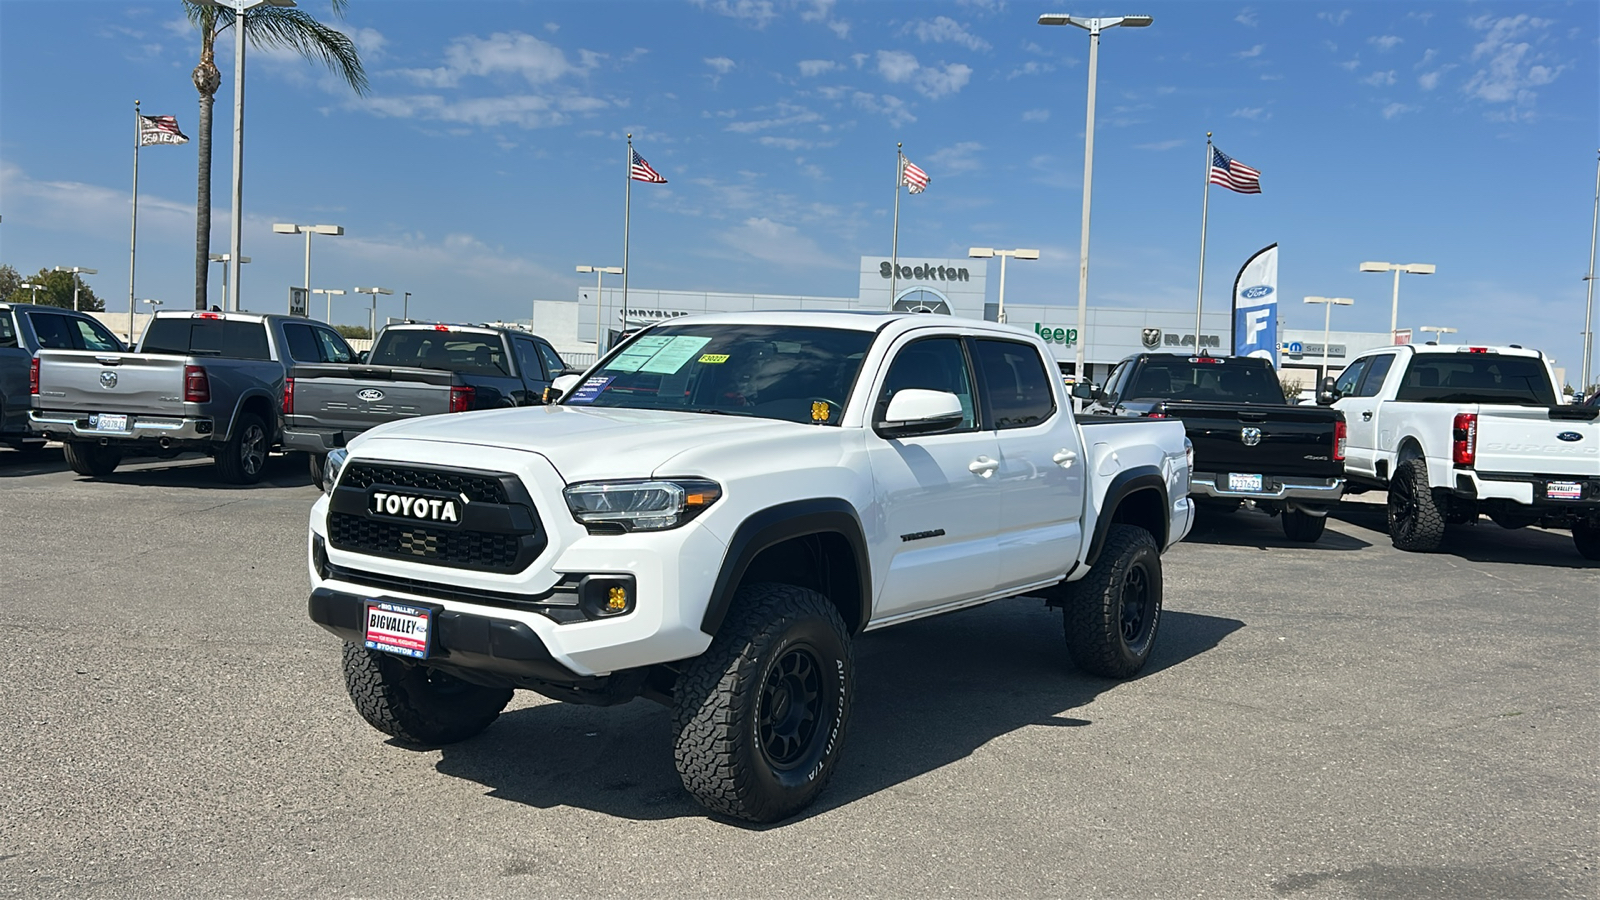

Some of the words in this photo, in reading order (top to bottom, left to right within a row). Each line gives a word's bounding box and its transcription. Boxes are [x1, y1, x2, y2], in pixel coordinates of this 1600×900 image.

[142, 133, 158, 144] 250
[880, 261, 969, 282] Stockton
[1247, 287, 1267, 298] Ford
[1164, 334, 1220, 348] RAM
[1306, 345, 1340, 353] Servce
[1487, 443, 1576, 454] SUPER
[374, 493, 457, 522] TOYOTA
[393, 605, 415, 614] VALLEY
[369, 613, 417, 634] BIGVALLEY
[377, 643, 413, 655] STOCKTON
[825, 659, 846, 755] All-Terrain
[808, 761, 824, 781] T/A
